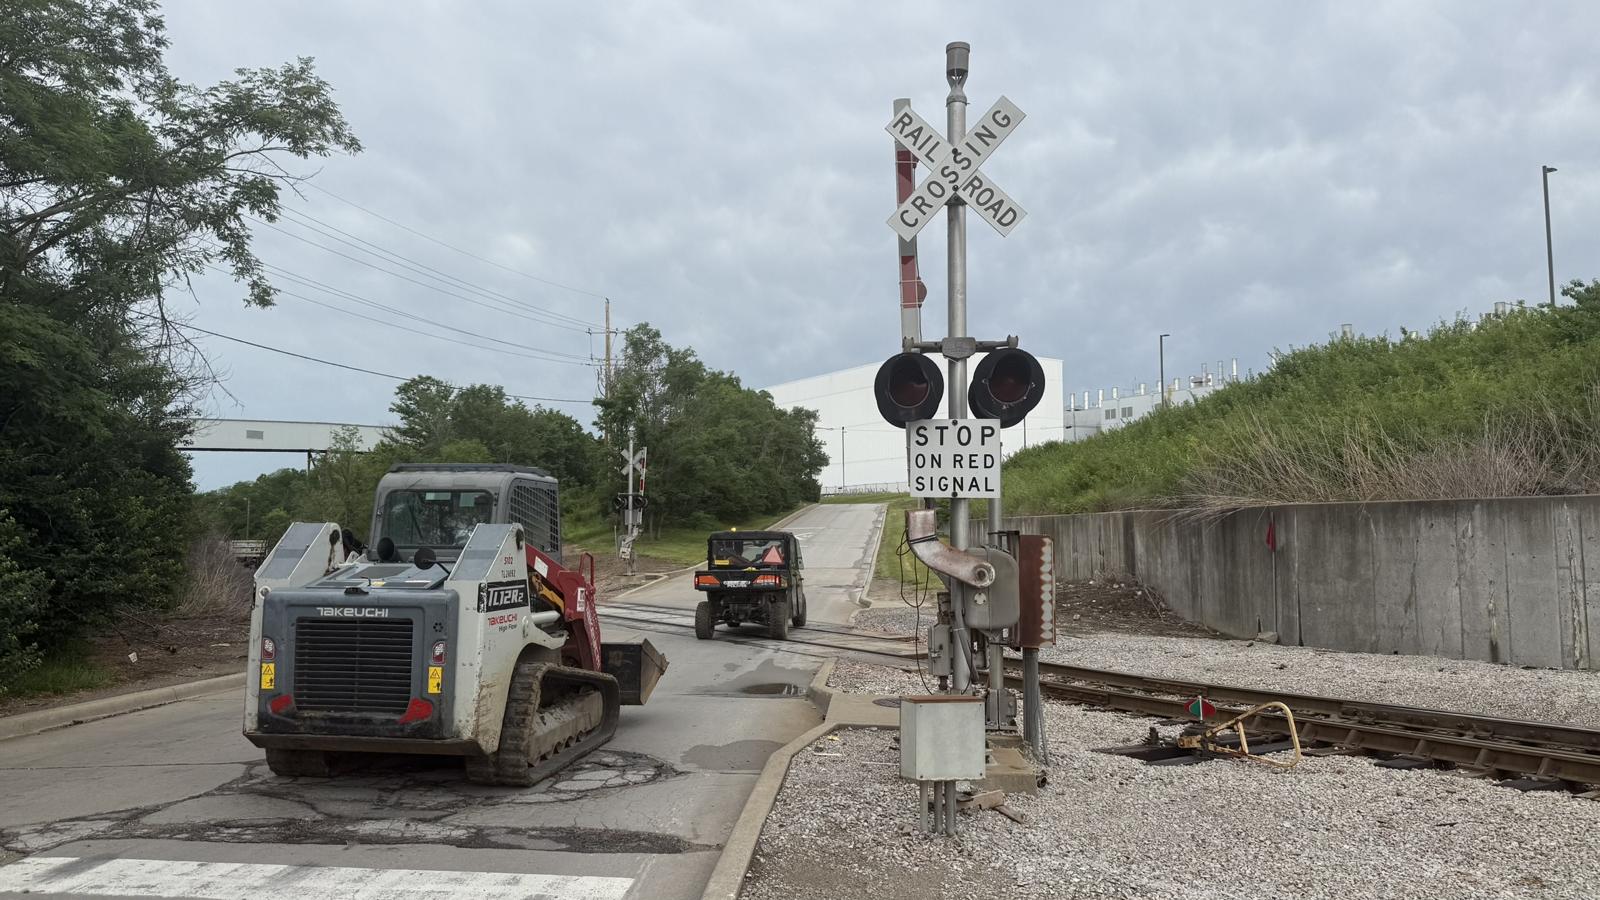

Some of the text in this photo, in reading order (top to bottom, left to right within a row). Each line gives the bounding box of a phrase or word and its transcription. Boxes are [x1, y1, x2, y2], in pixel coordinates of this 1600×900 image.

[892, 112, 940, 163] RAIL
[900, 109, 1011, 228] CROSSING
[962, 175, 1018, 227] ROAD
[915, 425, 995, 446] STOP
[915, 453, 995, 469] ON RED
[915, 476, 995, 492] SIGNAL
[487, 584, 525, 607] TL12R2
[316, 607, 389, 618] TAKEUCHI
[487, 613, 518, 627] TAKEUCHI
